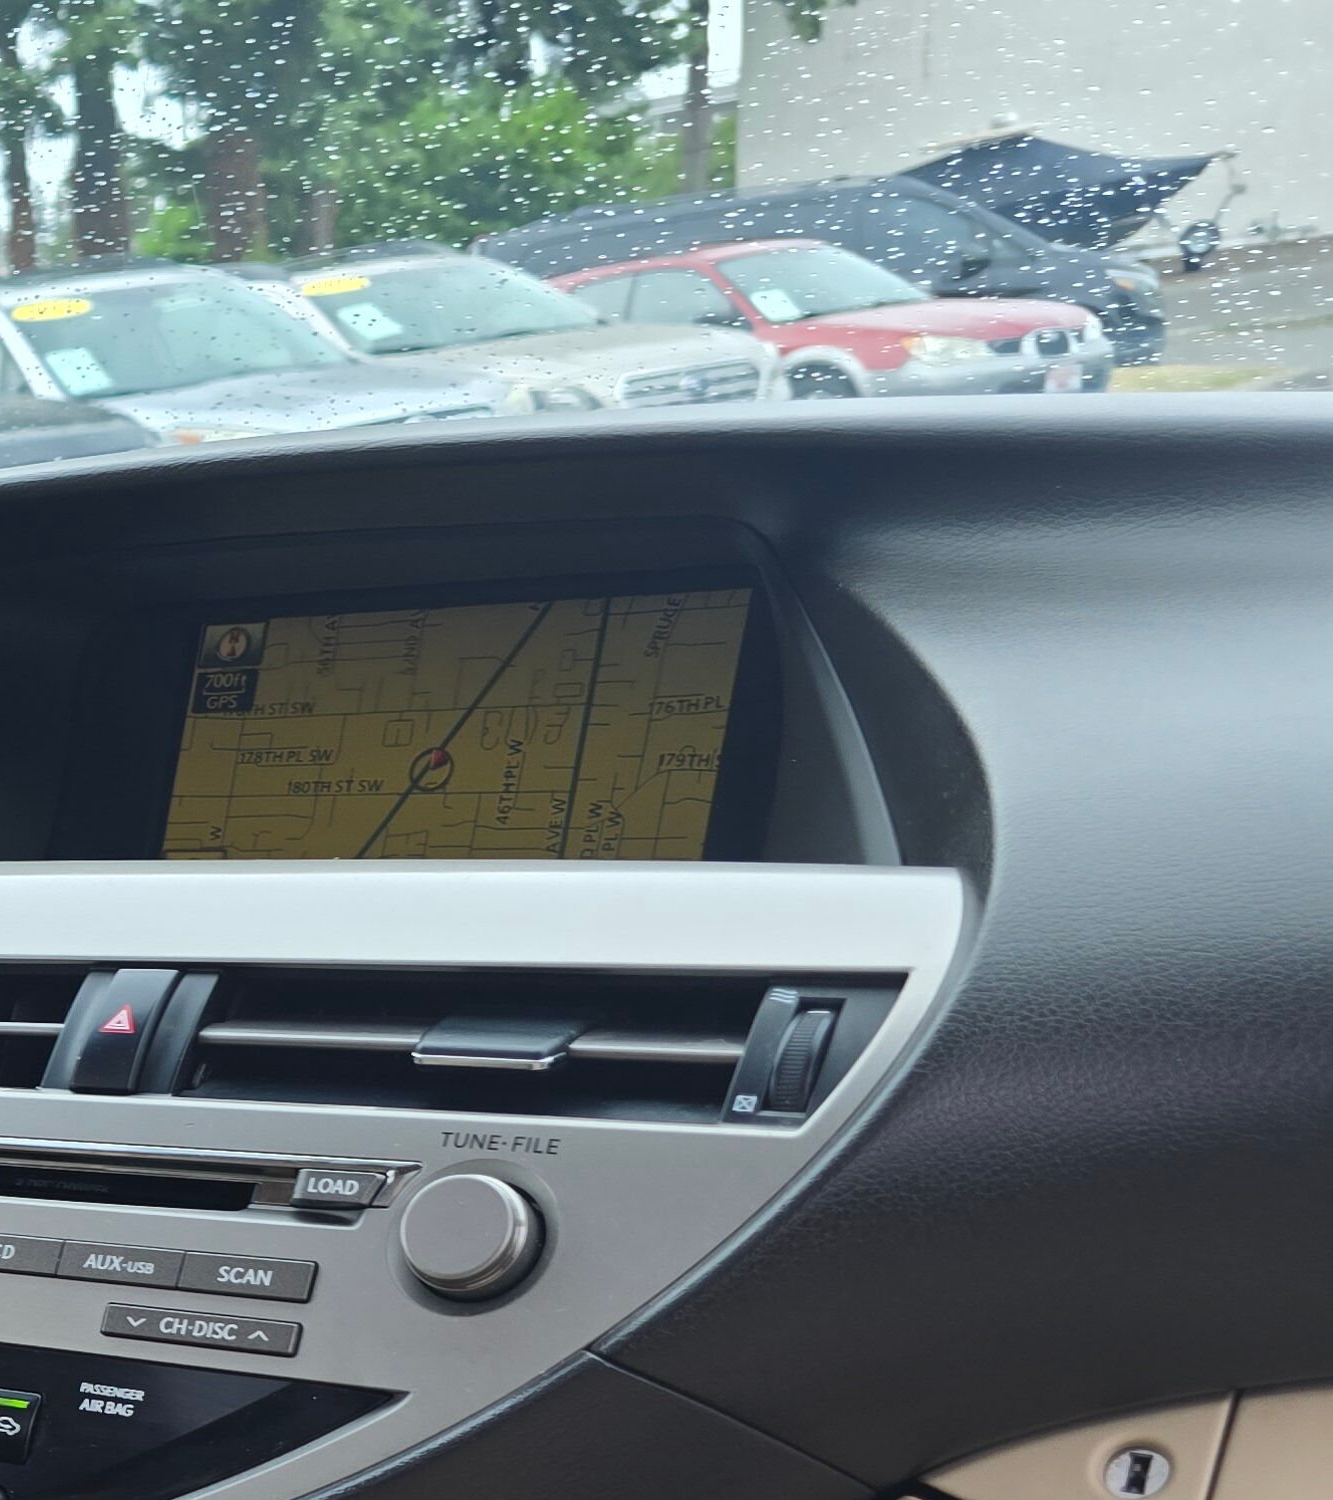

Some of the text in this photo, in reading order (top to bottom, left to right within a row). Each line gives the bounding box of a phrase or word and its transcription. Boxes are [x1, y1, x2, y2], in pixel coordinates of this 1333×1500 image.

[645, 597, 682, 658] SPRUCE
[205, 673, 247, 689] 700ft
[206, 695, 238, 709] GPS
[703, 696, 723, 709] PL
[286, 750, 304, 763] PL
[309, 749, 334, 762] SW
[508, 739, 524, 757] W
[504, 761, 520, 779] PL
[287, 778, 385, 794] 180TH ST SW
[551, 797, 567, 815] W
[587, 802, 603, 819] W
[584, 824, 599, 843] PL
[601, 810, 623, 852] PL W
[305, 1176, 360, 1196] LOAD
[216, 1265, 273, 1287] SCAN
[79, 1382, 145, 1401] PASSENGER
[79, 1398, 135, 1417] AIR BAG
